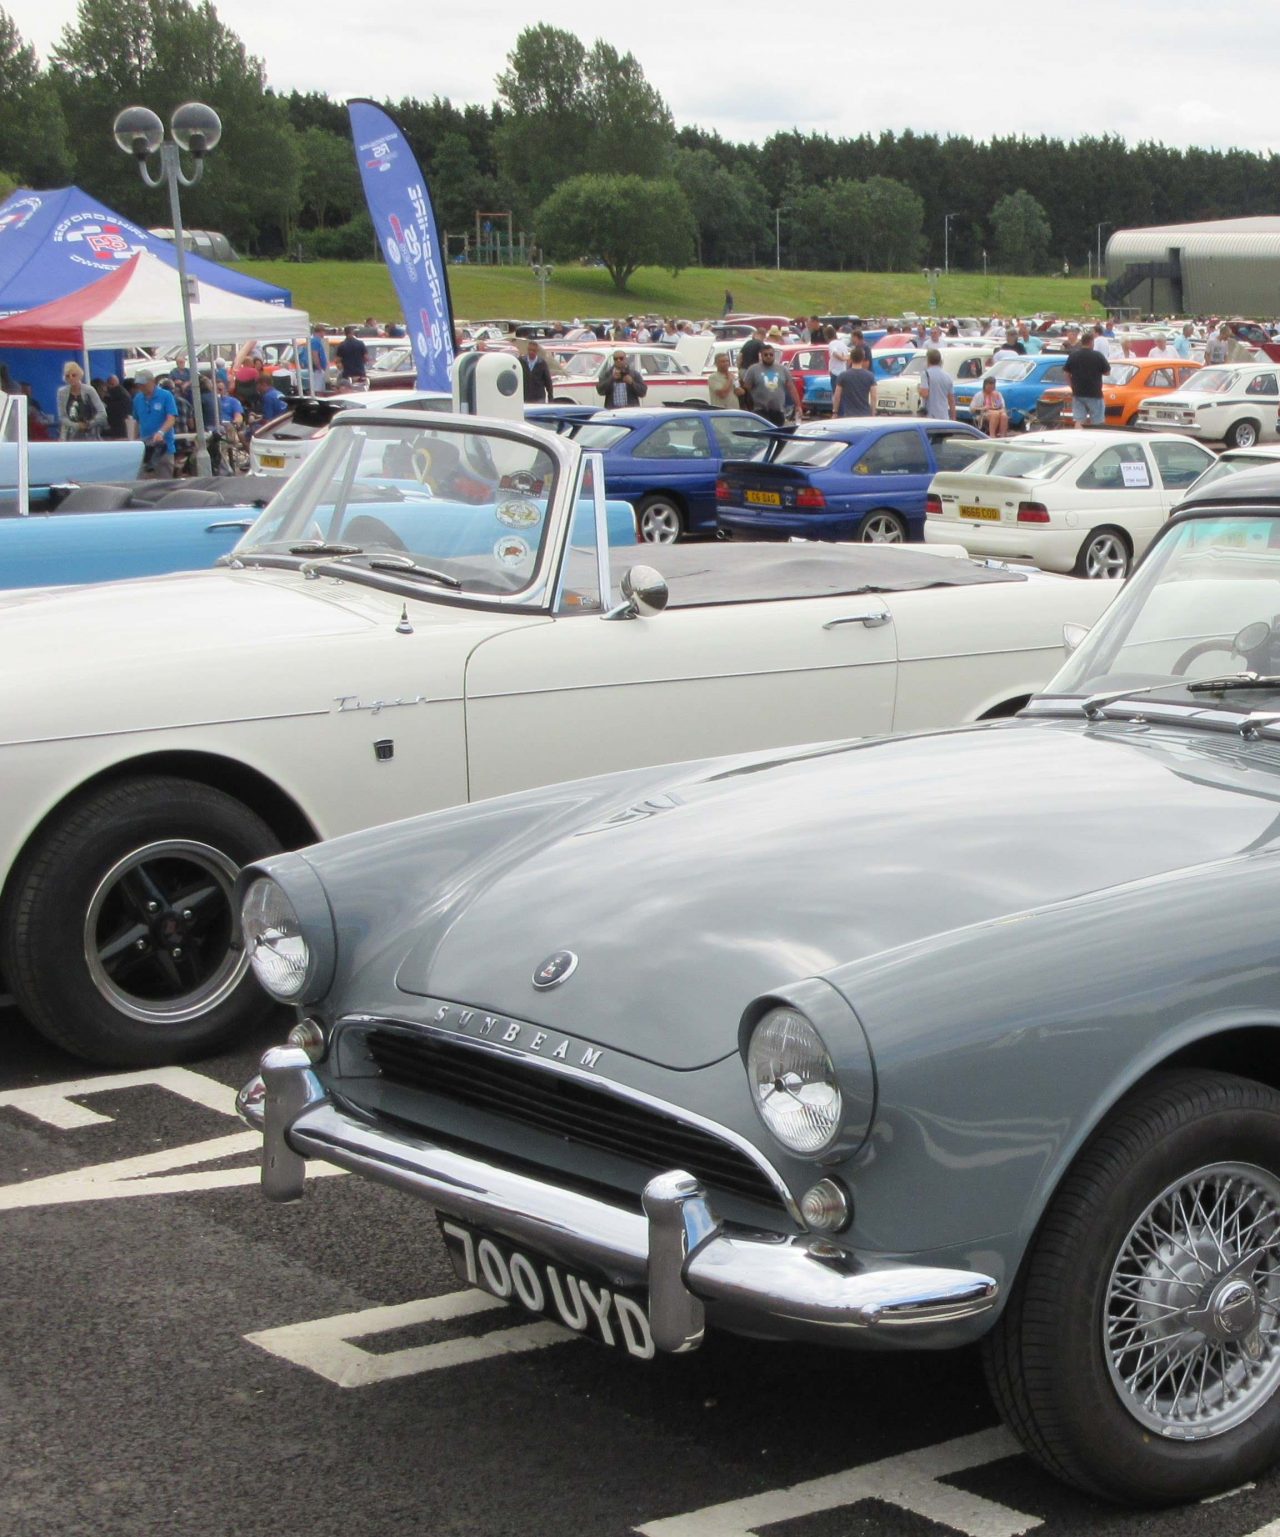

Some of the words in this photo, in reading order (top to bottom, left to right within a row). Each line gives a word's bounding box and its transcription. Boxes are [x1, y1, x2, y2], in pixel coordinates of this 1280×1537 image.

[53, 212, 149, 242] BEDFORDSHIRE
[86, 233, 128, 252] RS
[434, 1005, 603, 1068] SUNBEAM
[443, 1221, 545, 1312] 700
[546, 1264, 655, 1360] UYD
